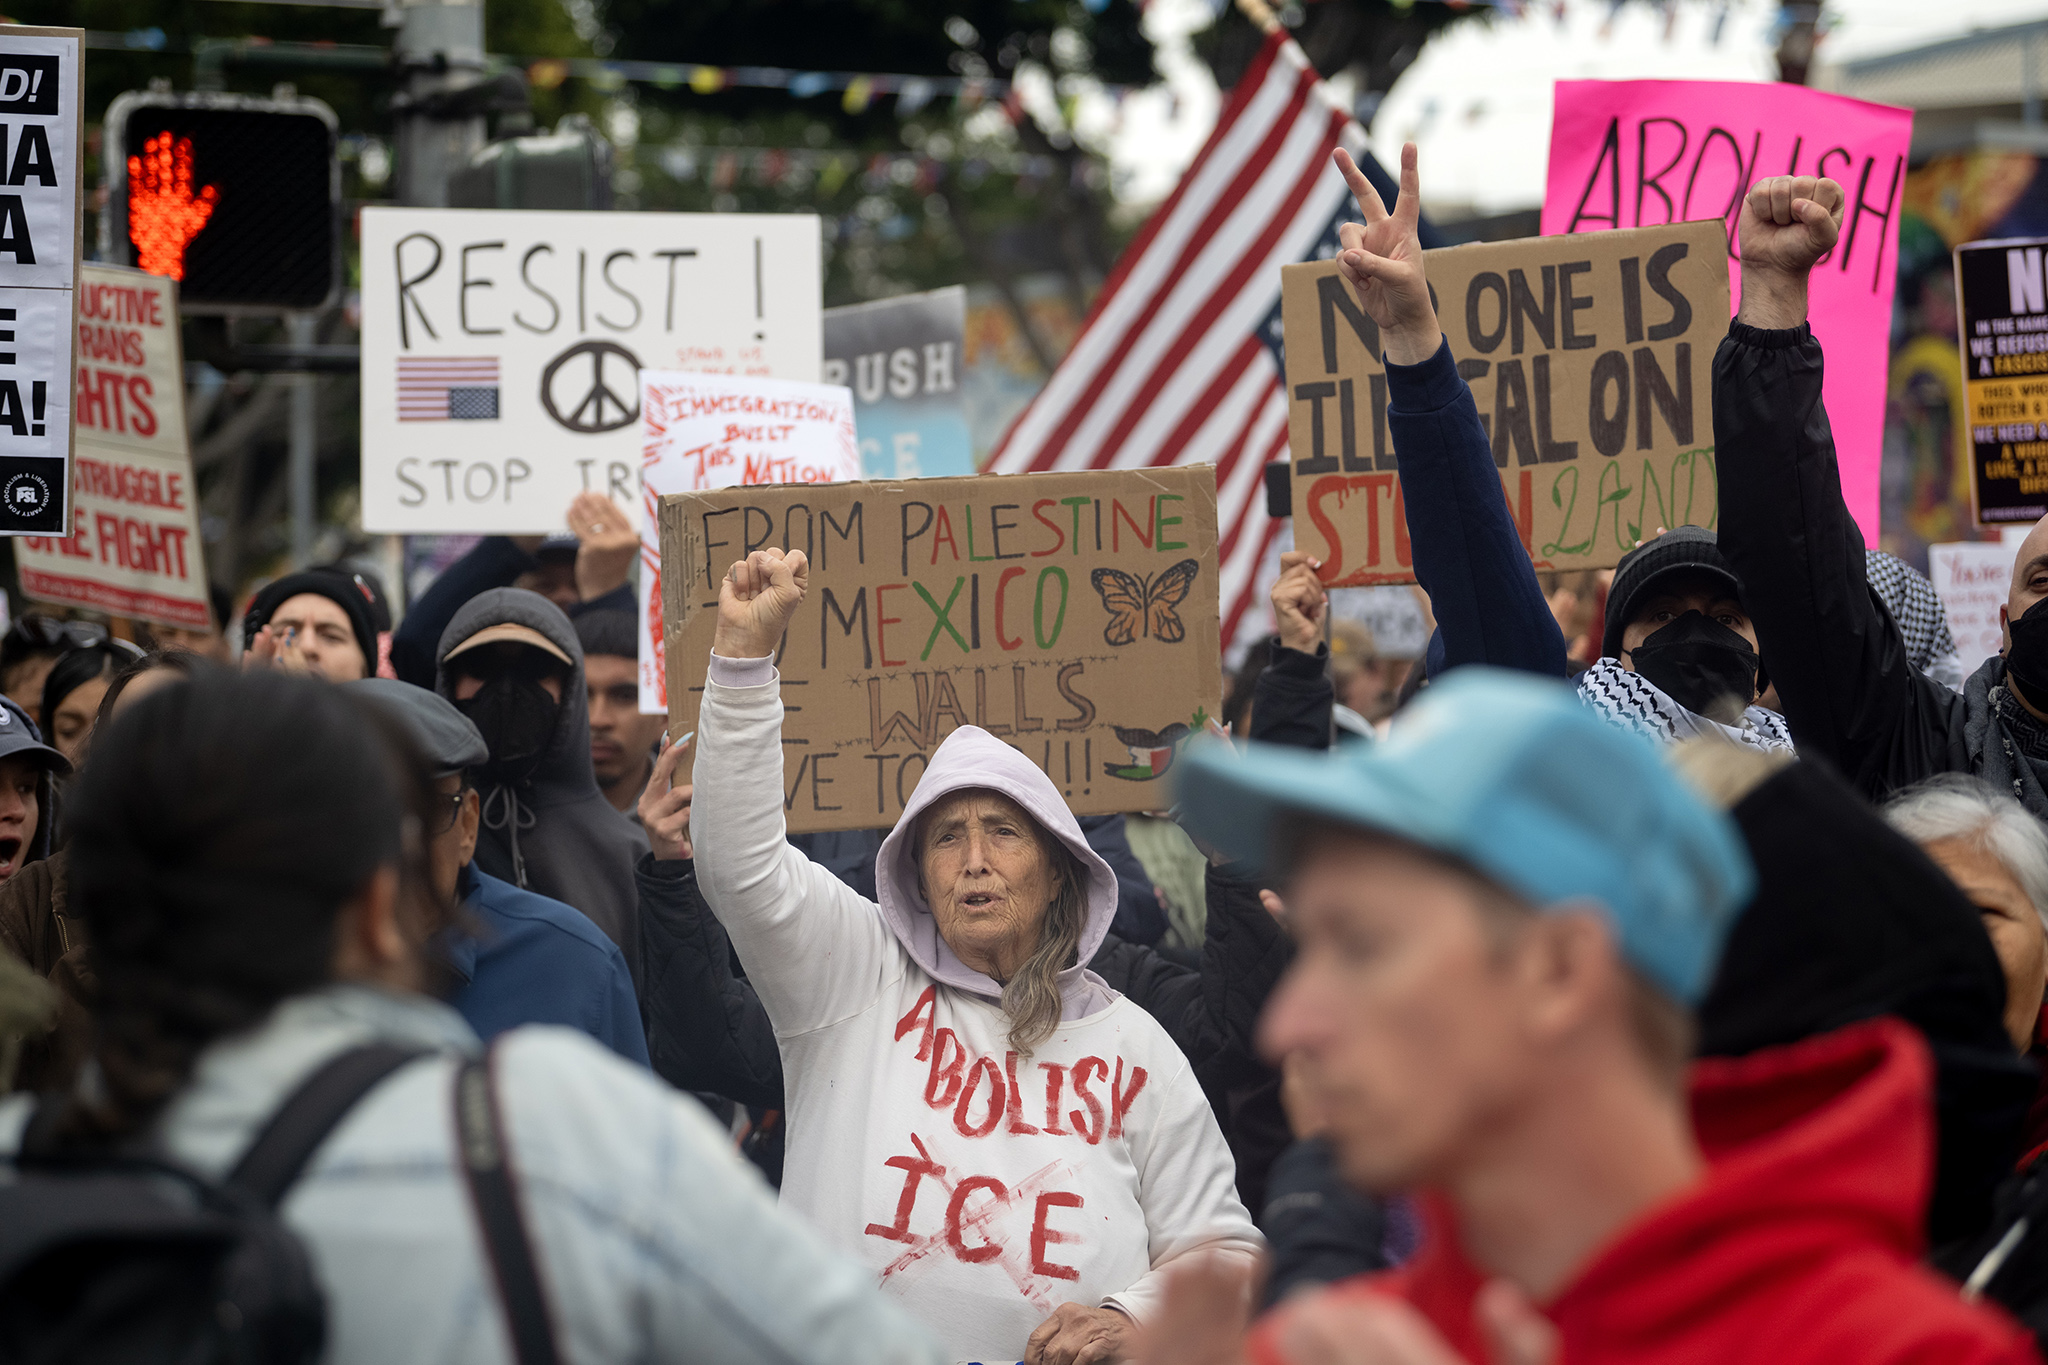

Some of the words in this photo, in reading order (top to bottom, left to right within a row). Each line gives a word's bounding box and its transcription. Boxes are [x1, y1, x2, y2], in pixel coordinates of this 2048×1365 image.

[395, 232, 699, 350] RESIST
[752, 236, 766, 342] !
[1316, 274, 1438, 374] N
[1465, 261, 1597, 355] ONE
[1620, 243, 1693, 344] IS
[2006, 247, 2048, 315] N
[1970, 337, 1994, 358] WE
[1979, 357, 1992, 376] A
[77, 367, 158, 439] HTS
[668, 393, 837, 424] IMMIGRATION
[1294, 353, 1578, 475] ILLGAL
[1588, 343, 1694, 457] ON
[722, 423, 796, 444] BUILT
[1998, 423, 2035, 442] NEED
[16, 489, 38, 503] PSL
[31, 474, 50, 507] LIBERATION
[75, 457, 185, 511] TRUGGLE
[396, 457, 533, 508] STOP
[742, 452, 835, 485] NATION
[95, 511, 188, 580] FIGHT
[702, 501, 864, 589] FROM
[901, 495, 1188, 577] PALESTINE
[821, 566, 1069, 669] MEXICO
[867, 662, 1096, 752] WALLS
[784, 752, 843, 810] VE
[864, 1154, 1086, 1284] ICE
